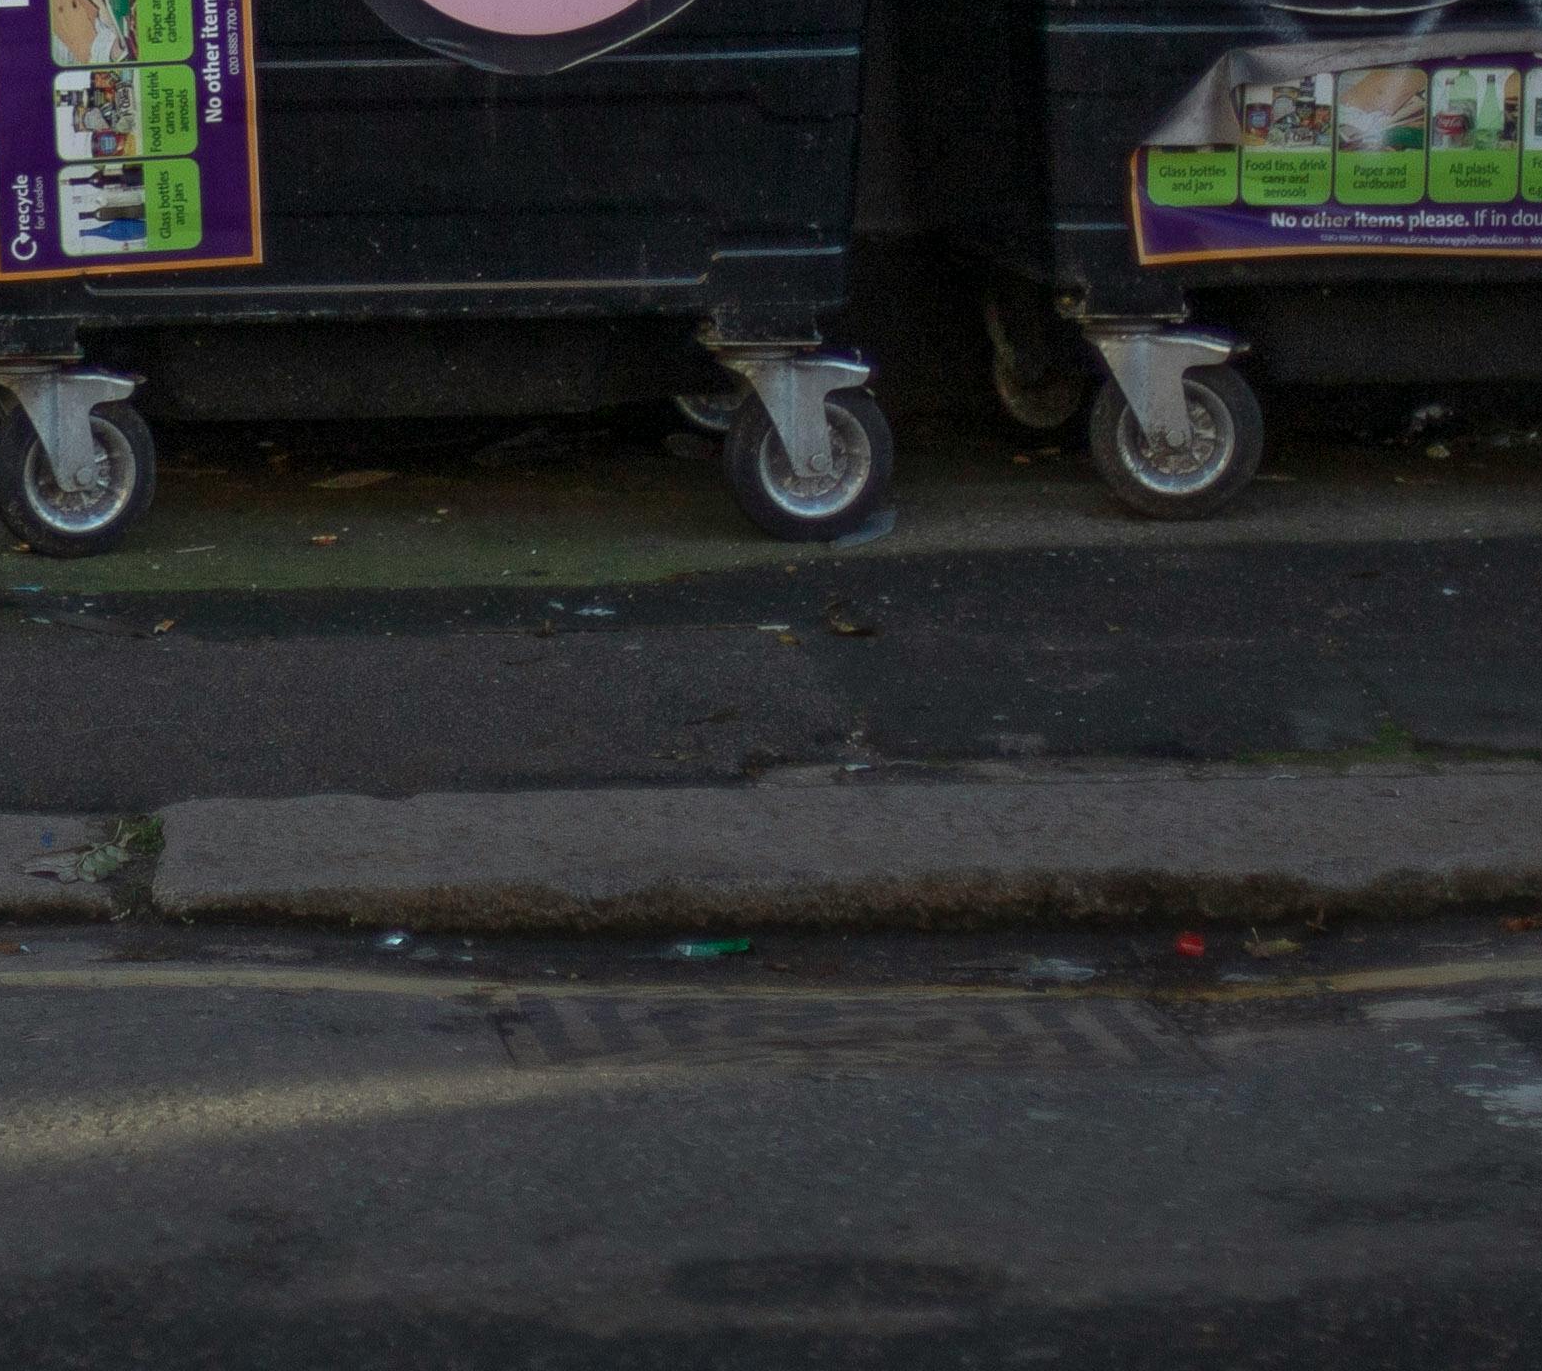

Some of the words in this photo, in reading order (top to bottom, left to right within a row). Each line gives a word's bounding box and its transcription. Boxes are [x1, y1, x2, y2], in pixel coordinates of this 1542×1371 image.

[150, 12, 165, 44] Paper
[226, 8, 237, 30] 7700
[203, 43, 221, 93] other
[229, 56, 239, 75] 020
[148, 71, 159, 99] drink
[162, 88, 174, 108] and
[149, 101, 161, 124] tins,
[176, 89, 189, 132] aerosols
[205, 97, 222, 123] No
[163, 110, 175, 135] cans
[149, 127, 162, 153] Food
[1159, 165, 1187, 178] Glass
[1189, 165, 1226, 178] bottles
[1245, 160, 1272, 172] Food
[1299, 159, 1327, 171] drink
[1353, 166, 1383, 179] Paper
[1385, 164, 1406, 177] and
[1467, 162, 1500, 177] plastic
[157, 171, 170, 209] bottles
[1172, 179, 1192, 191] and
[1353, 177, 1406, 189] cardboard
[1454, 176, 1492, 189] bottles
[11, 174, 34, 231] recycle
[34, 176, 44, 213] London
[174, 183, 188, 205] jars
[35, 216, 45, 230] for
[159, 211, 171, 239] Glass
[172, 206, 185, 226] and
[1271, 211, 1295, 228] No
[1300, 211, 1351, 229] other
[1354, 211, 1404, 228] items
[1408, 211, 1469, 232] please.
[1474, 210, 1490, 226] If
[1491, 210, 1507, 226] in
